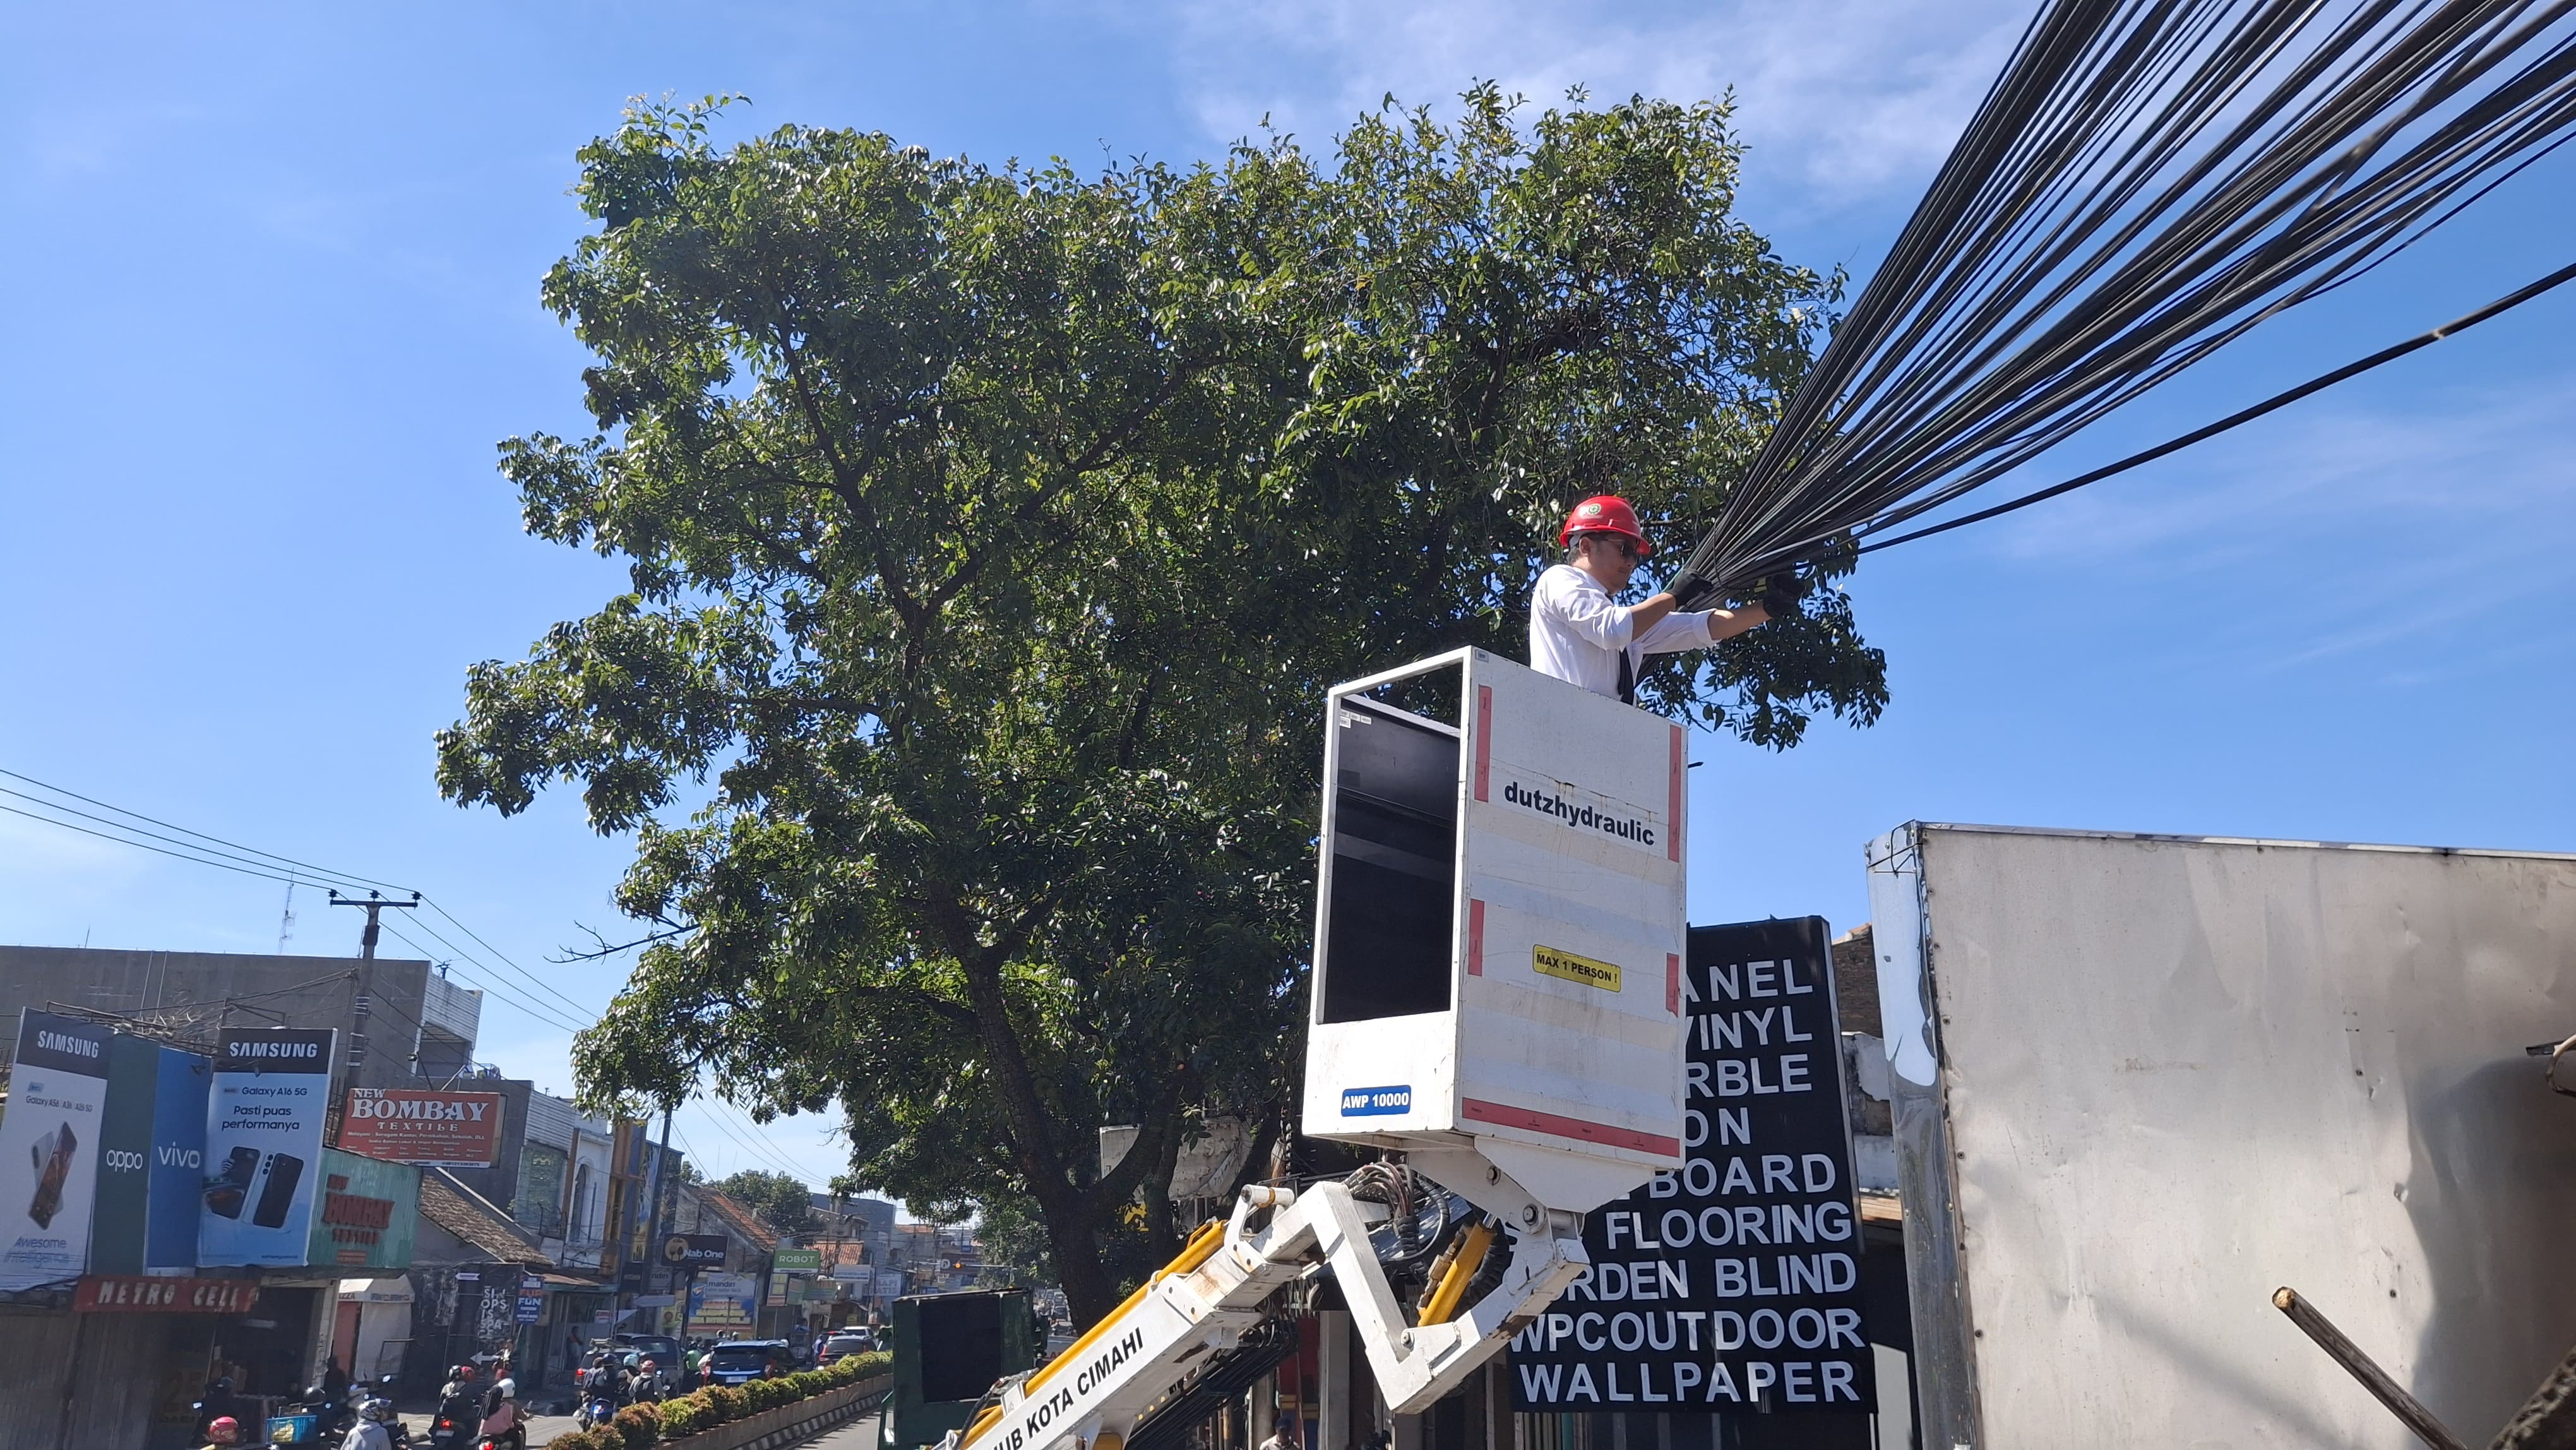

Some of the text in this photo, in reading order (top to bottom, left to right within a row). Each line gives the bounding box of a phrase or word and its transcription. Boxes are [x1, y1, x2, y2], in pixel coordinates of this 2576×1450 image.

[1505, 782, 1655, 846] dutzhydraulic
[1537, 954, 1559, 969] MAX
[1563, 961, 1567, 971] 1
[1571, 963, 1611, 981] PERSON
[1685, 1005, 1813, 1051] INYL
[38, 1030, 99, 1058] SAMSUNG
[229, 1042, 318, 1058] SAMSUNG
[26, 1095, 47, 1107] Galaxy
[242, 1087, 276, 1098] Galaxy
[277, 1088, 292, 1096] A16
[354, 1089, 386, 1098] NEW
[1342, 1093, 1409, 1109] AWP 10000
[234, 1105, 292, 1118] Pasti puas
[351, 1099, 489, 1122] BOMBAY
[222, 1120, 299, 1132] performanya
[378, 1122, 459, 1132] TEXTILE
[107, 1149, 143, 1173] oppo
[158, 1141, 200, 1168] vivo
[1649, 1154, 1836, 1199] BOARD
[1606, 1201, 1852, 1250] FLOORING
[14, 1237, 66, 1249] Awesome
[704, 1250, 724, 1258] One
[1715, 1252, 1856, 1297] BLIND
[1026, 1387, 1074, 1439] KOTA
[1077, 1327, 1143, 1396] CIMAHI
[1519, 1361, 1860, 1403] WALLPAPER
